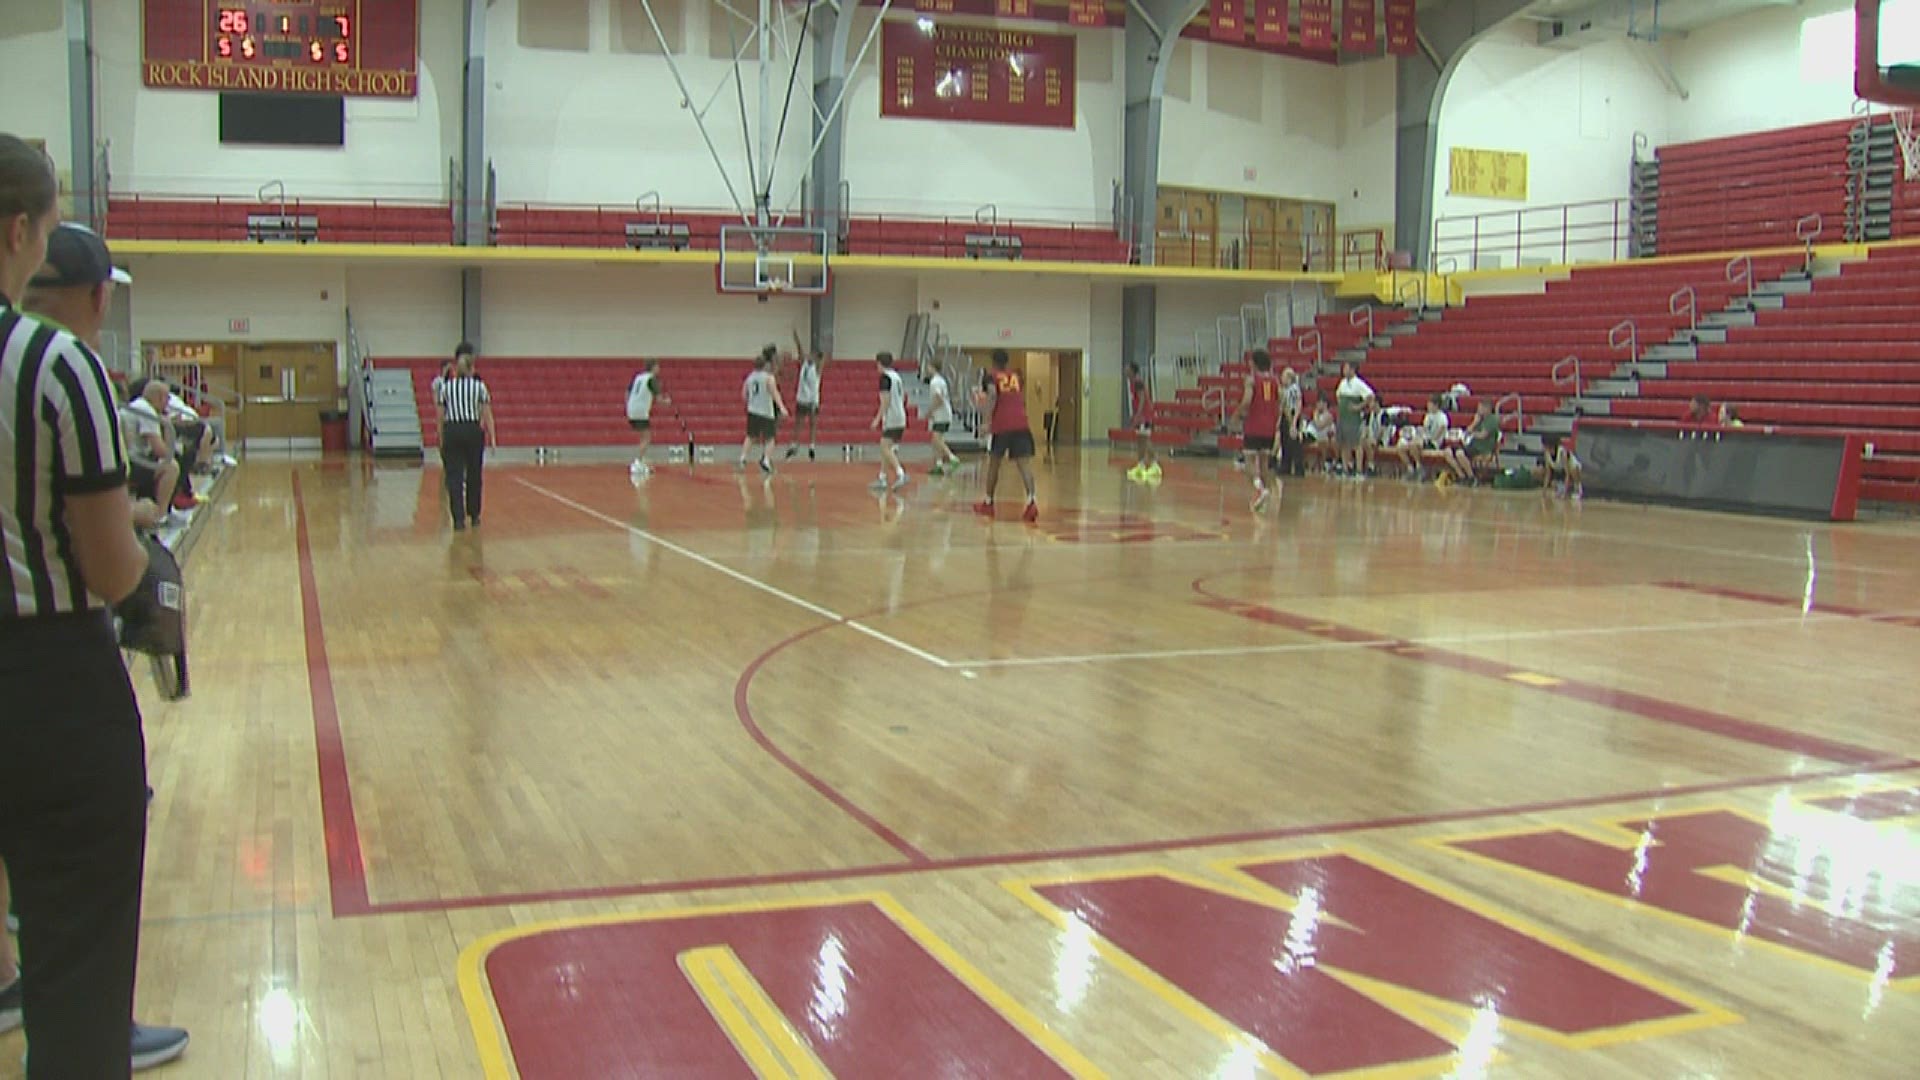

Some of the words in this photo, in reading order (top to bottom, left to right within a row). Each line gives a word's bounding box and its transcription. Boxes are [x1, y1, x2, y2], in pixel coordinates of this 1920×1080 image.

[219, 11, 247, 33] 26
[336, 17, 349, 37] 7
[935, 45, 1022, 61] CHAMPIO
[150, 64, 201, 86] ROCK
[208, 65, 278, 89] ISLAND
[283, 69, 331, 91] HIGH
[336, 71, 411, 94] SCHOOL
[997, 372, 1020, 392] 24
